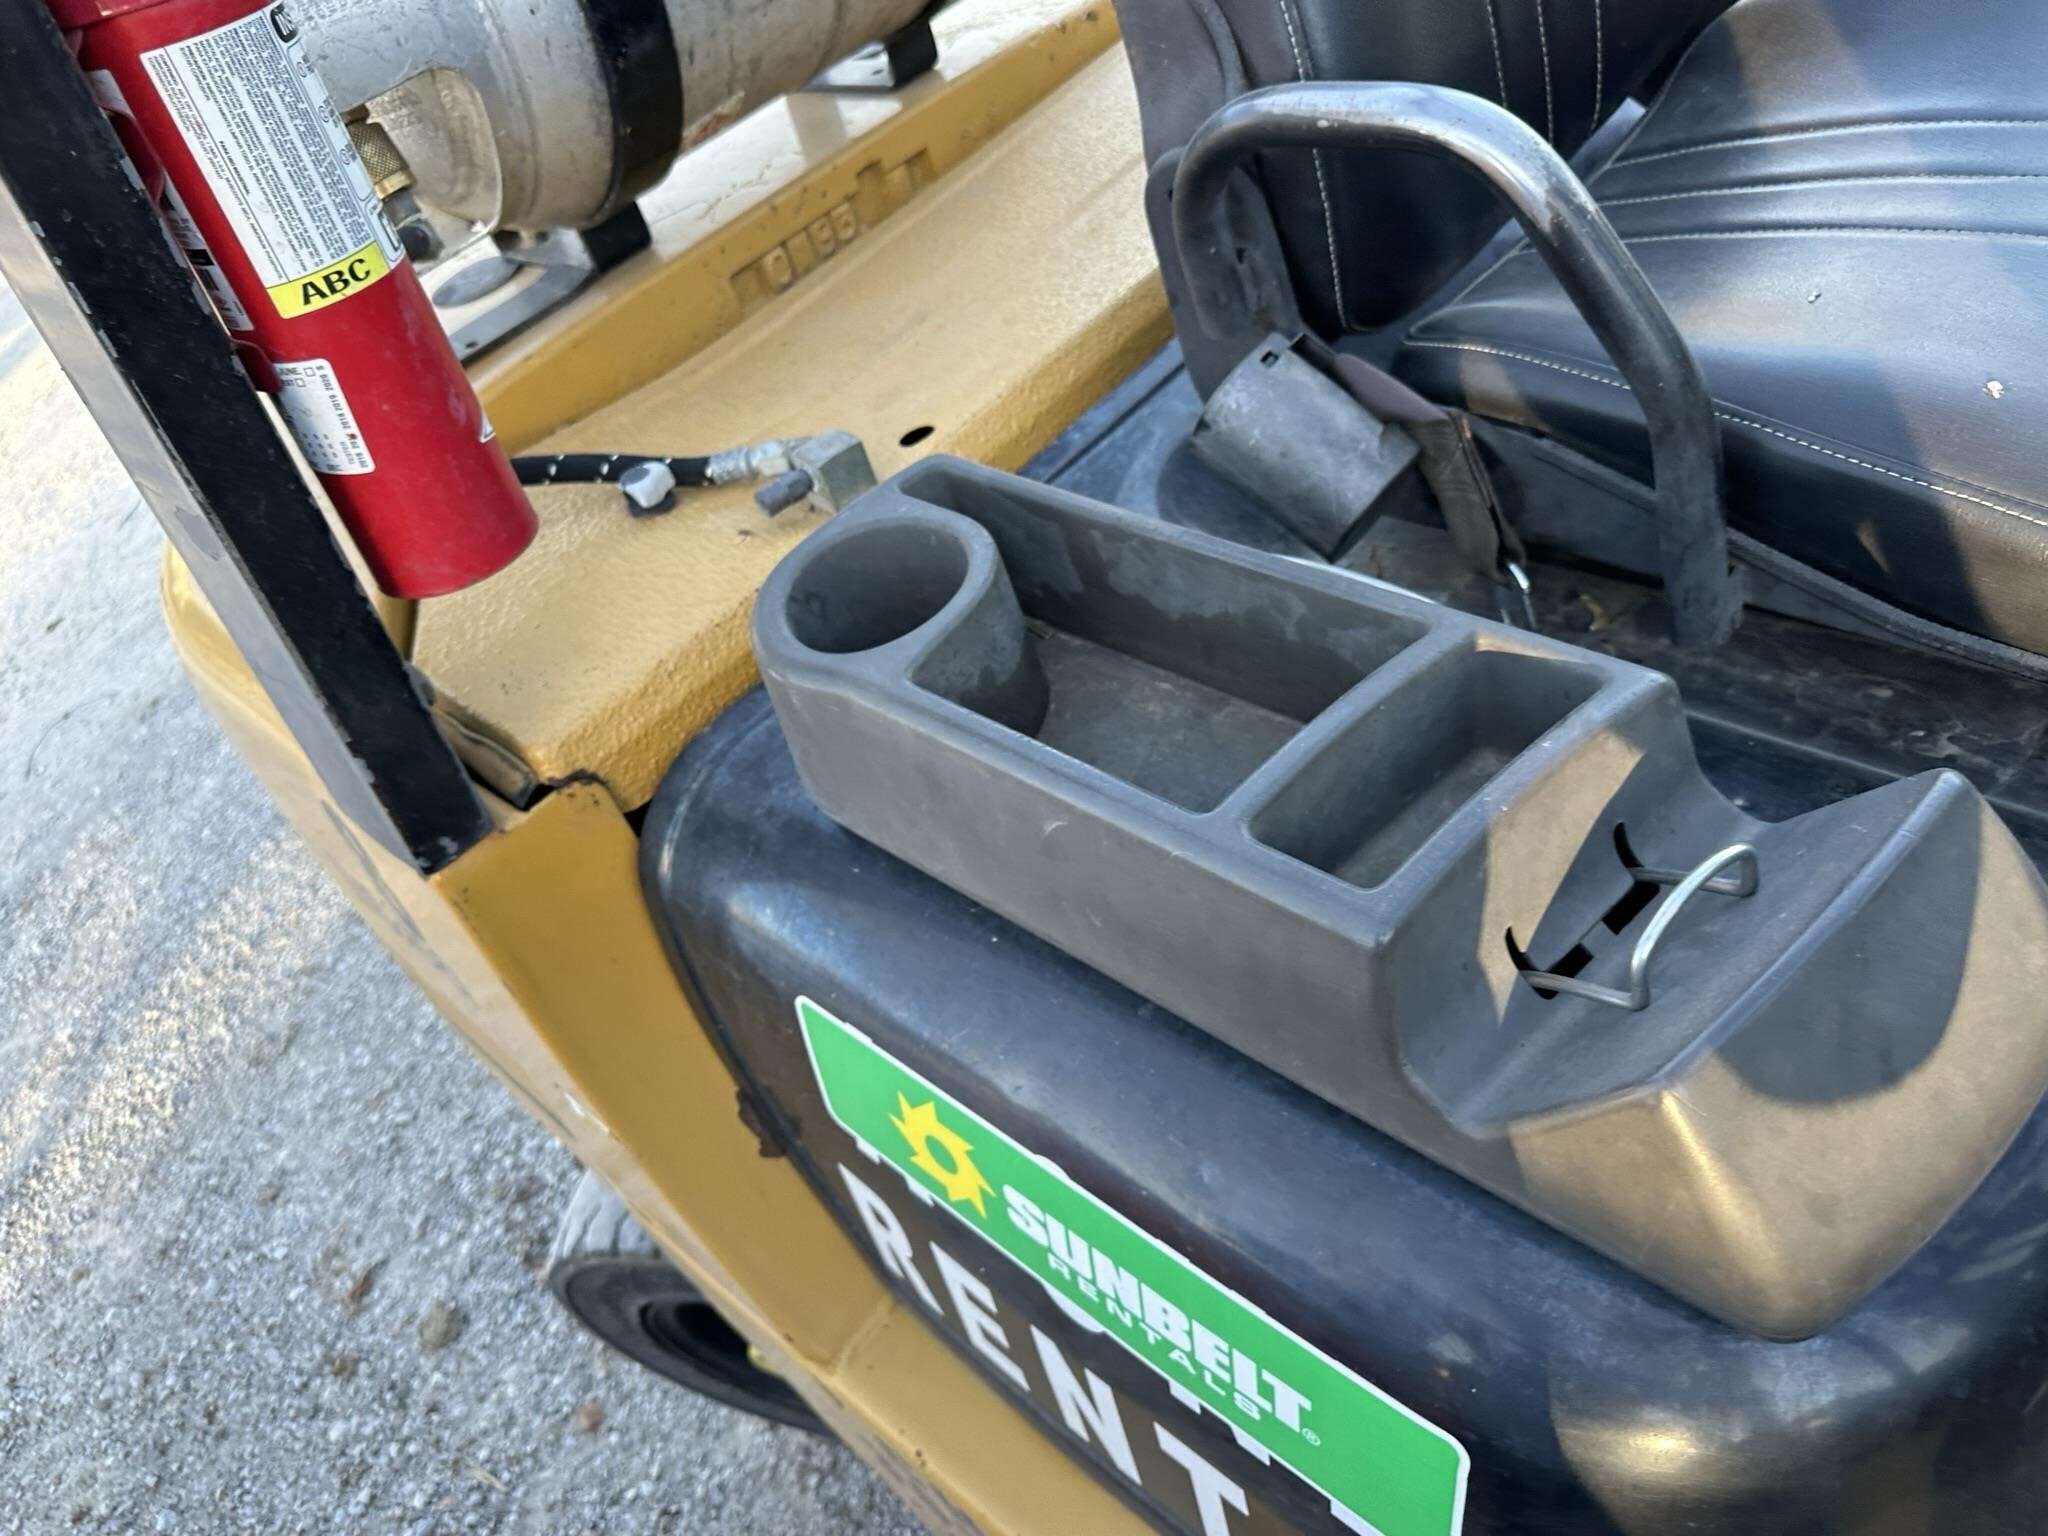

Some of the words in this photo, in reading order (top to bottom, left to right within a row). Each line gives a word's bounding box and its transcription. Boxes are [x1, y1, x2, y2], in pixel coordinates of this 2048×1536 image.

[301, 257, 371, 306] ABC
[838, 1162, 1250, 1536] RENT
[1002, 1183, 1312, 1433] SUNBELT
[1046, 1251, 1264, 1422] RENTALS
